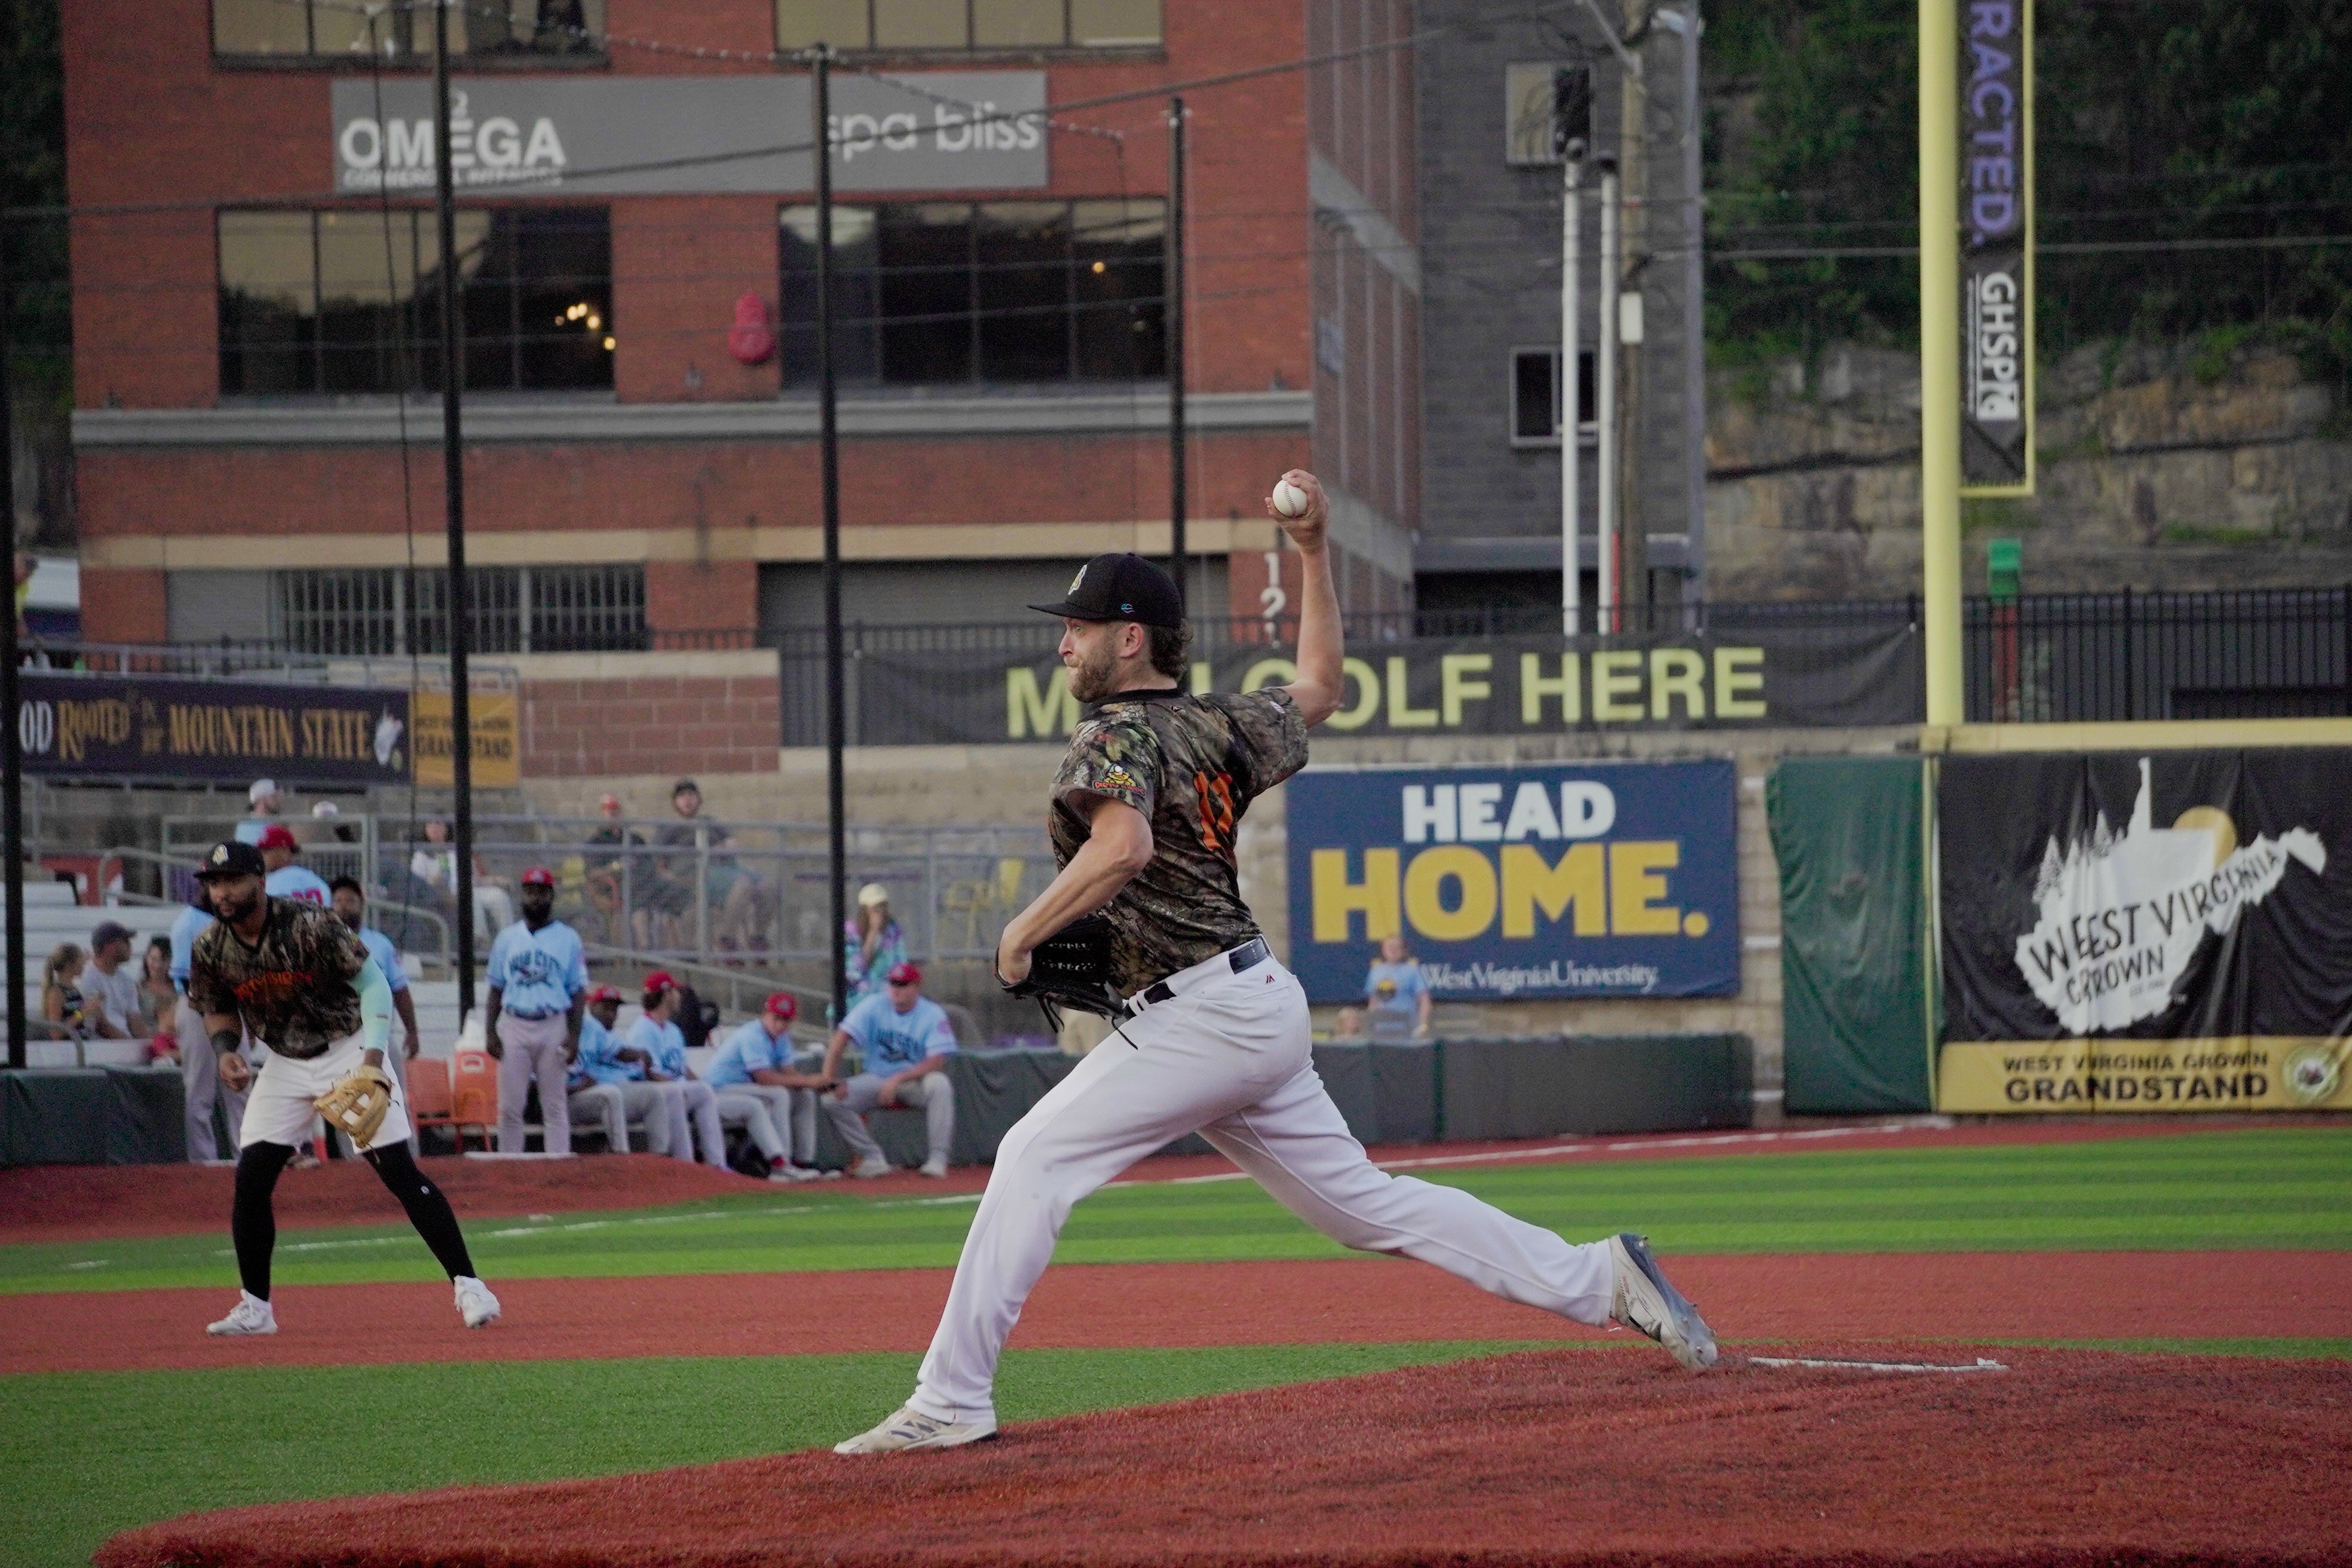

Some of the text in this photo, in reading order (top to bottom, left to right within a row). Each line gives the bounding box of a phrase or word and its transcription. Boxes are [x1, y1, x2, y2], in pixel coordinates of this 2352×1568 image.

[339, 118, 567, 169] OMEGA
[935, 101, 1040, 152] bliss
[1520, 646, 1768, 723] HERE
[169, 704, 293, 758] MOUNTAIN
[301, 708, 371, 761] STATE
[1402, 780, 1616, 844] HEAD
[1311, 840, 1710, 944] HOME.
[2004, 1055, 2064, 1072] WEST
[2005, 1072, 2269, 1102] GRANDSTAND
